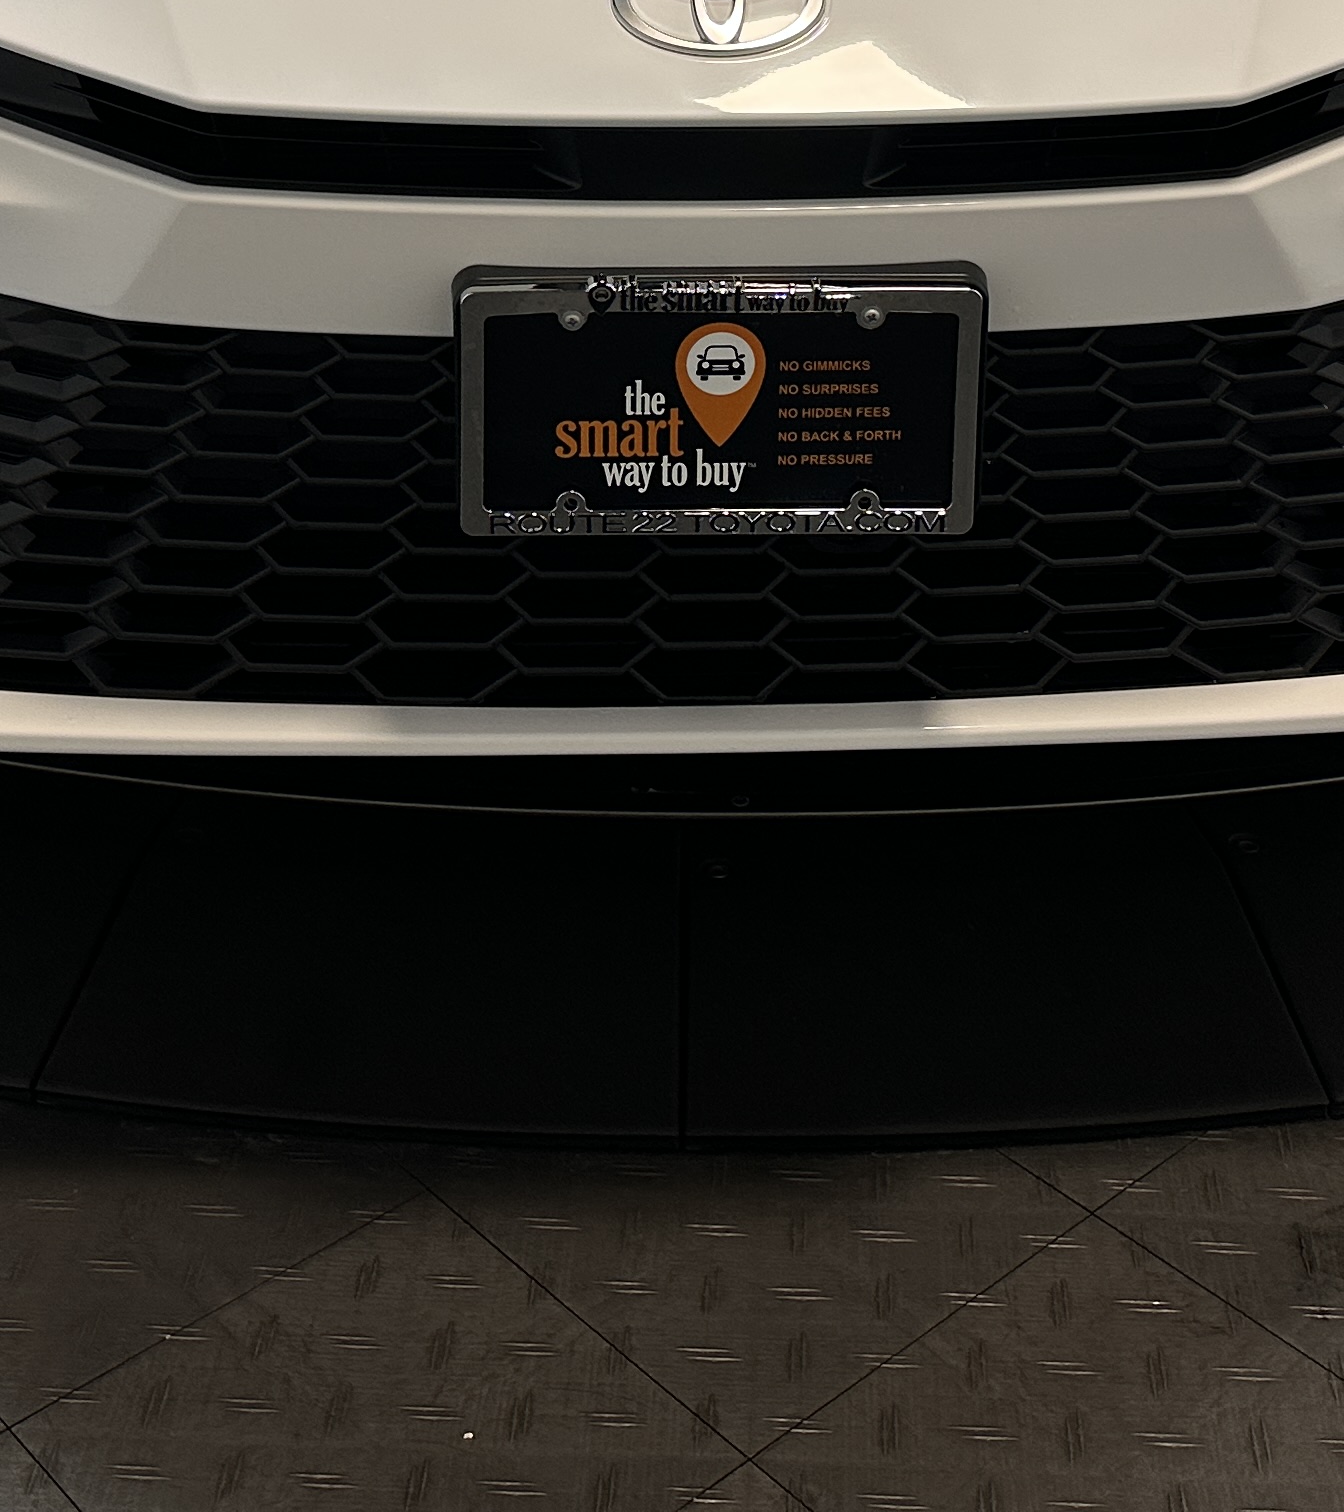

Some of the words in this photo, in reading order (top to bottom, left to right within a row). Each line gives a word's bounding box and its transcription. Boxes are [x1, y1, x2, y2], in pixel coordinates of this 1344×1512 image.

[620, 279, 657, 312] the
[661, 279, 745, 313] smart
[745, 292, 787, 314] way
[789, 284, 810, 312] to
[779, 361, 799, 371] NO
[803, 360, 871, 371] GIMMICKS
[625, 380, 665, 415] the
[778, 384, 799, 395] NO
[802, 384, 879, 395] SURPRISES
[778, 408, 798, 418] NO
[801, 408, 852, 418] HIDDEN
[856, 407, 890, 417] FEES
[555, 408, 684, 458] smart
[778, 431, 798, 442] NO
[801, 431, 839, 441] BACK
[843, 431, 852, 441] &
[856, 430, 901, 440] FORTH
[777, 455, 797, 465] NO
[801, 454, 873, 465] PRESSURE
[602, 462, 655, 493] way
[661, 455, 688, 486] to
[696, 449, 746, 492] buy
[489, 512, 627, 534] ROUTE
[632, 511, 677, 533] 22
[684, 510, 947, 534] TOYOTA.COM
